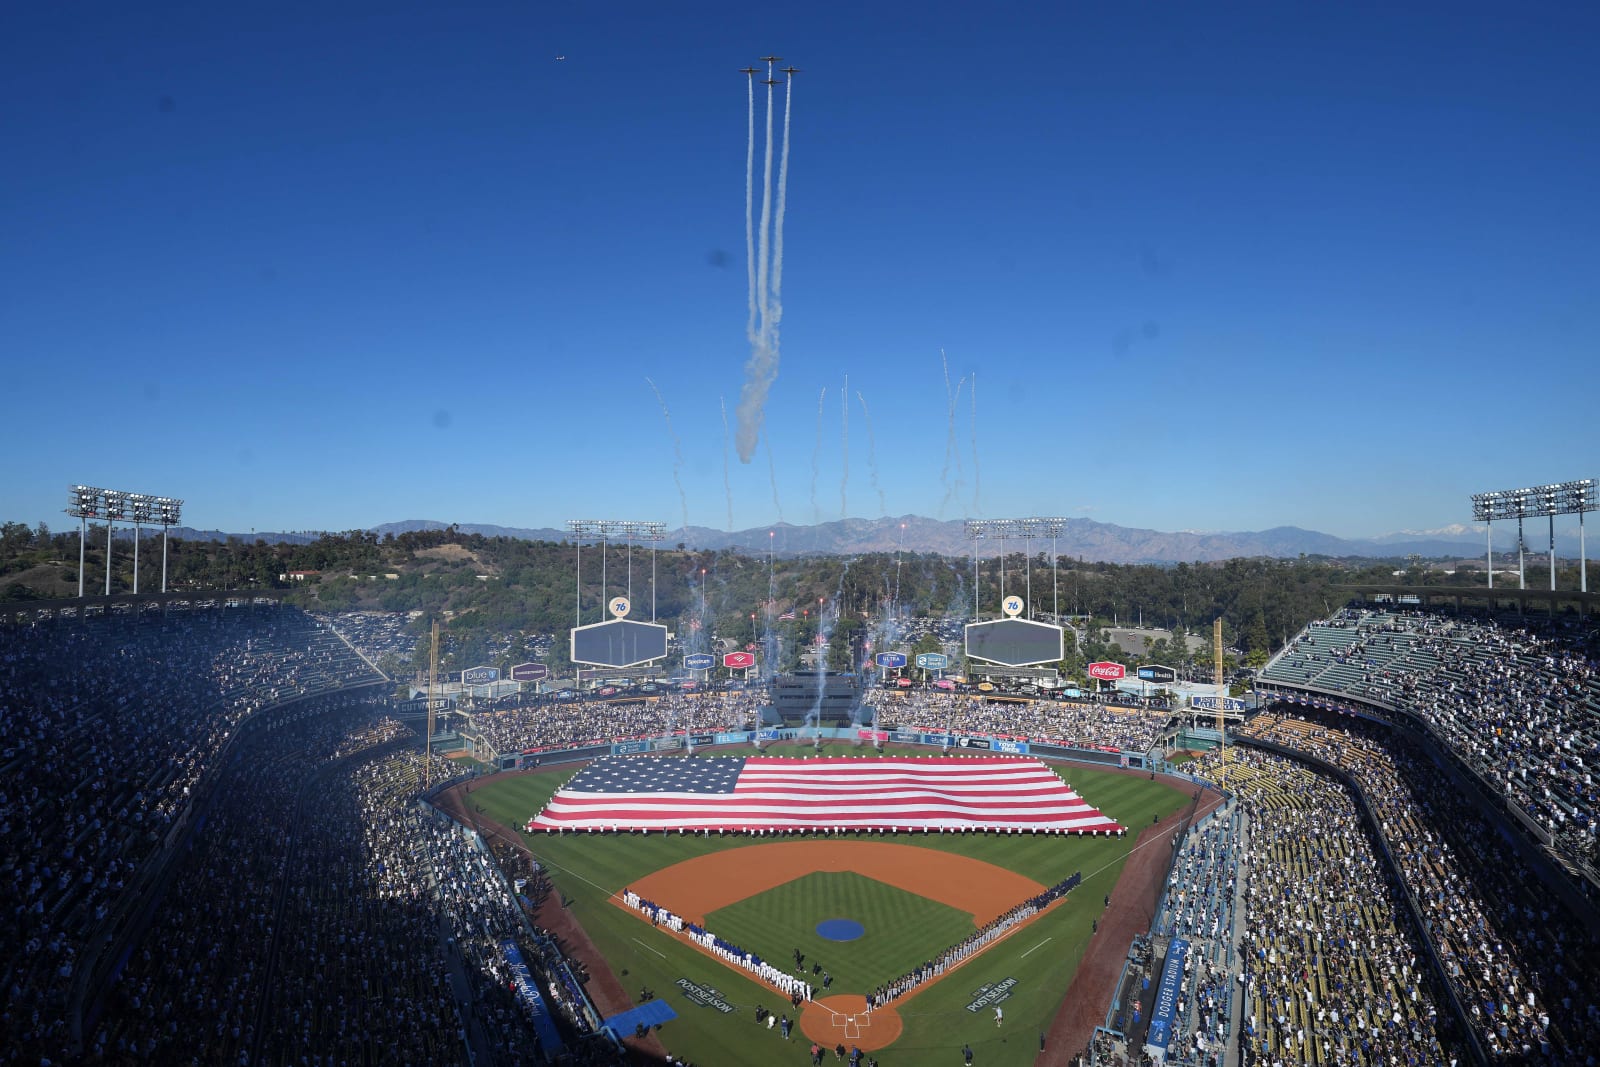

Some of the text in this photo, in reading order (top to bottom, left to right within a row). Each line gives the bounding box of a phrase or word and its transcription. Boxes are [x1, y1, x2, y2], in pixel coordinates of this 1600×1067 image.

[615, 603, 626, 612] 76
[1007, 601, 1019, 610] 76
[466, 671, 487, 680] blue
[1154, 671, 1173, 679] Health
[1158, 959, 1180, 1018] DODGER STADIUM
[676, 978, 733, 1013] POSTSEASON
[966, 977, 1018, 1012] POSTSEASON
